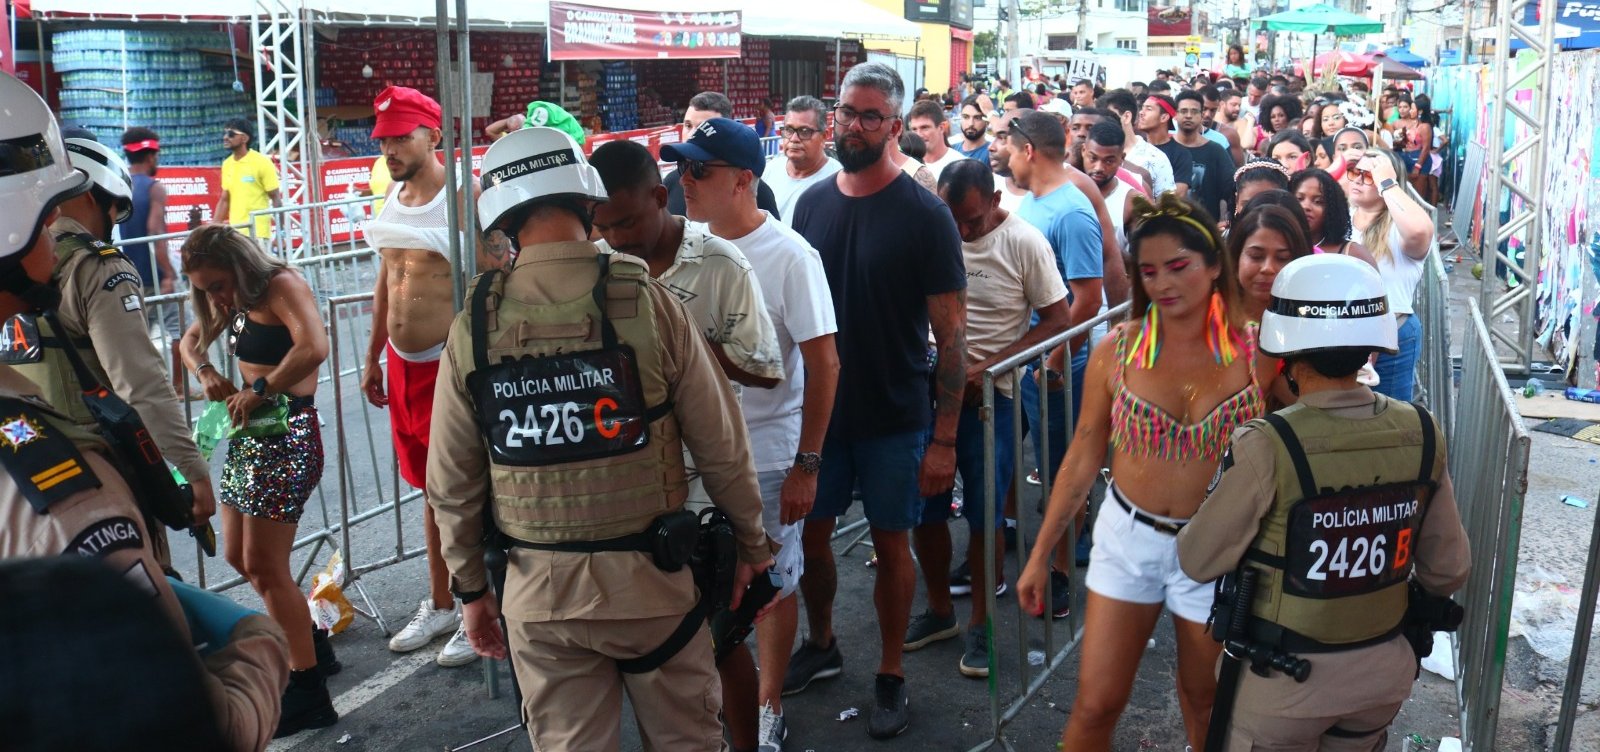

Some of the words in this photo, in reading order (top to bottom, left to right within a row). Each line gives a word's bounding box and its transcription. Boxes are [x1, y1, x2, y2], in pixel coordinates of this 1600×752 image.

[529, 153, 569, 171] MILITAR
[1304, 304, 1350, 316] POLÍCIA
[1350, 301, 1385, 316] MILITAR
[13, 318, 30, 352] A
[493, 376, 552, 399] POLÍCIA
[554, 368, 615, 392] MILITAR
[499, 401, 585, 448] 2426
[594, 397, 622, 439] C
[1312, 506, 1370, 529] POLÍCIA
[1372, 500, 1418, 524] MILITAR
[77, 522, 140, 557] ATINGA
[1306, 534, 1387, 581] 2426
[1393, 527, 1412, 570] B
